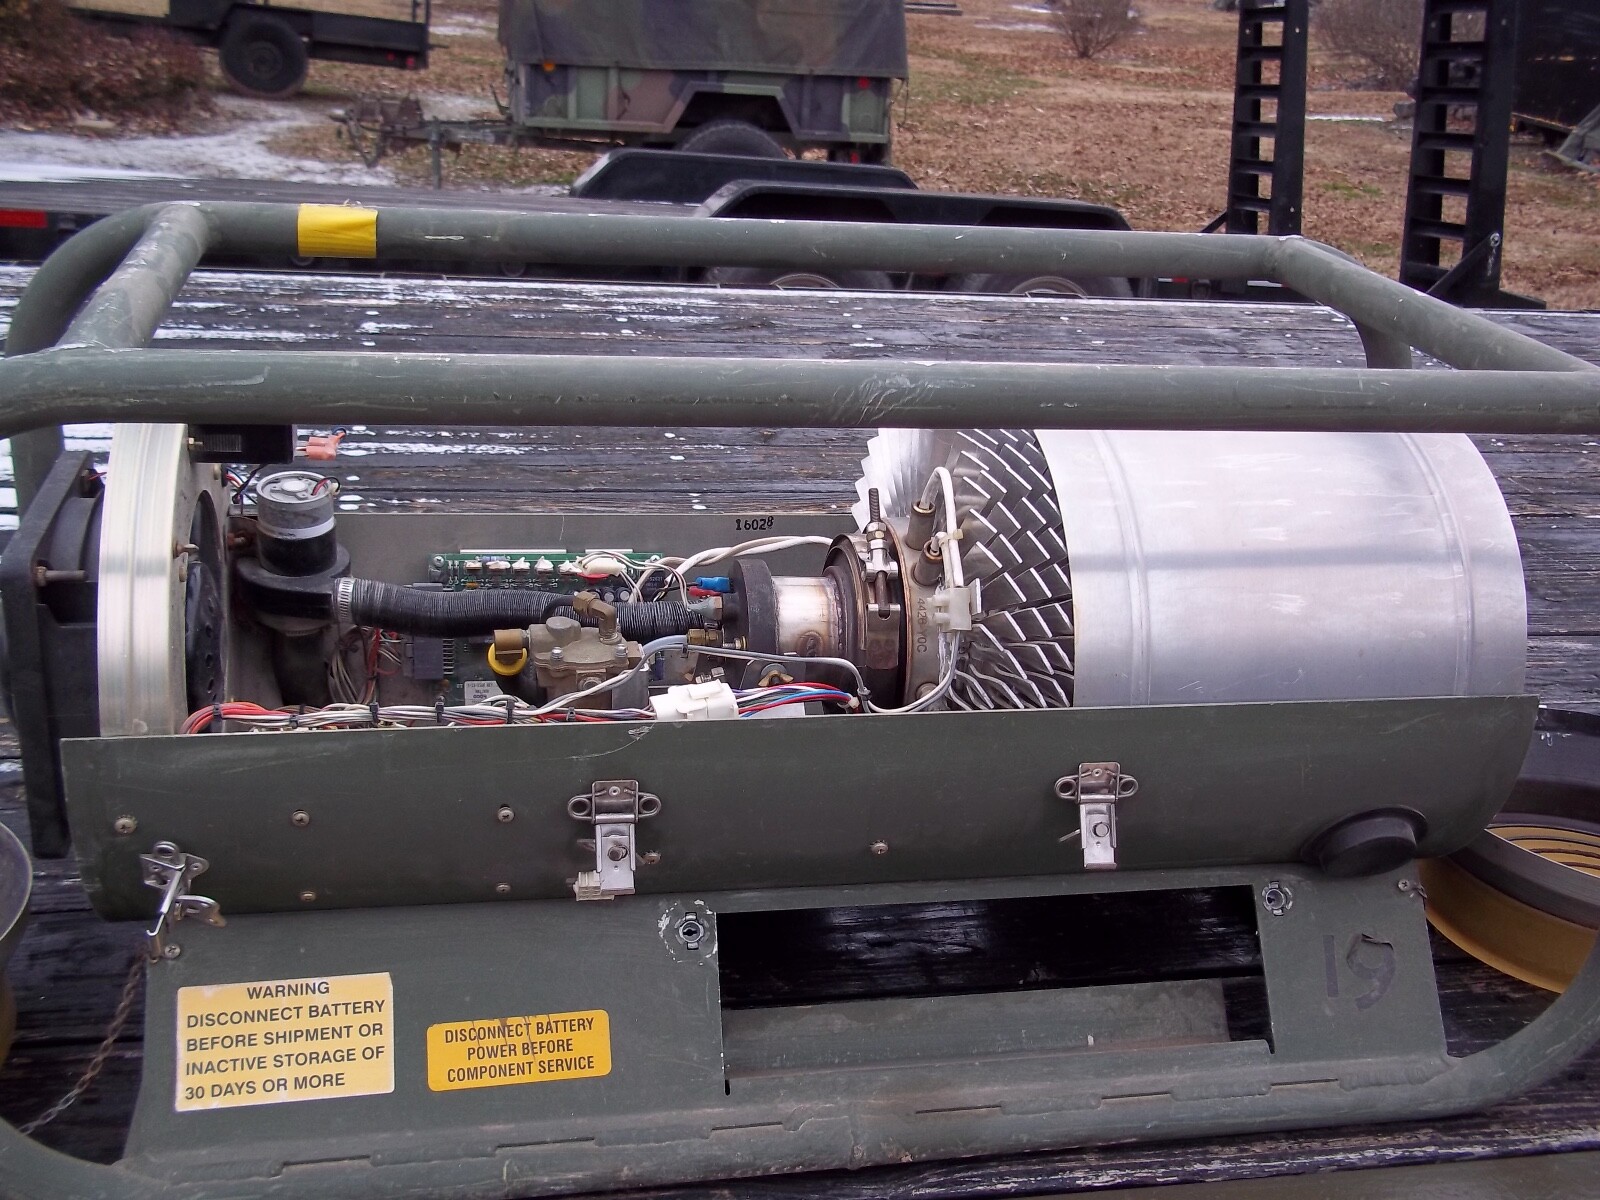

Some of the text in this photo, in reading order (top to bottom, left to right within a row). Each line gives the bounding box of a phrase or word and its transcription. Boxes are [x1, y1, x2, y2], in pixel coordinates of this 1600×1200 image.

[735, 515, 775, 530] 16028
[1322, 933, 1396, 1011] 19
[247, 981, 330, 1000] WARNING
[187, 999, 385, 1028] DISCONNECT BATTERY
[186, 1023, 383, 1051] BEFORE SHIPMENT OR
[445, 1017, 594, 1043] DISCONNECT BATTERY
[186, 1045, 385, 1075] INACTIVE STORAGE OF
[467, 1038, 574, 1060] POWER BEFORE
[447, 1055, 595, 1082] COMPONENT SERVICE
[185, 1072, 346, 1100] 30 DAYS OR MORE
